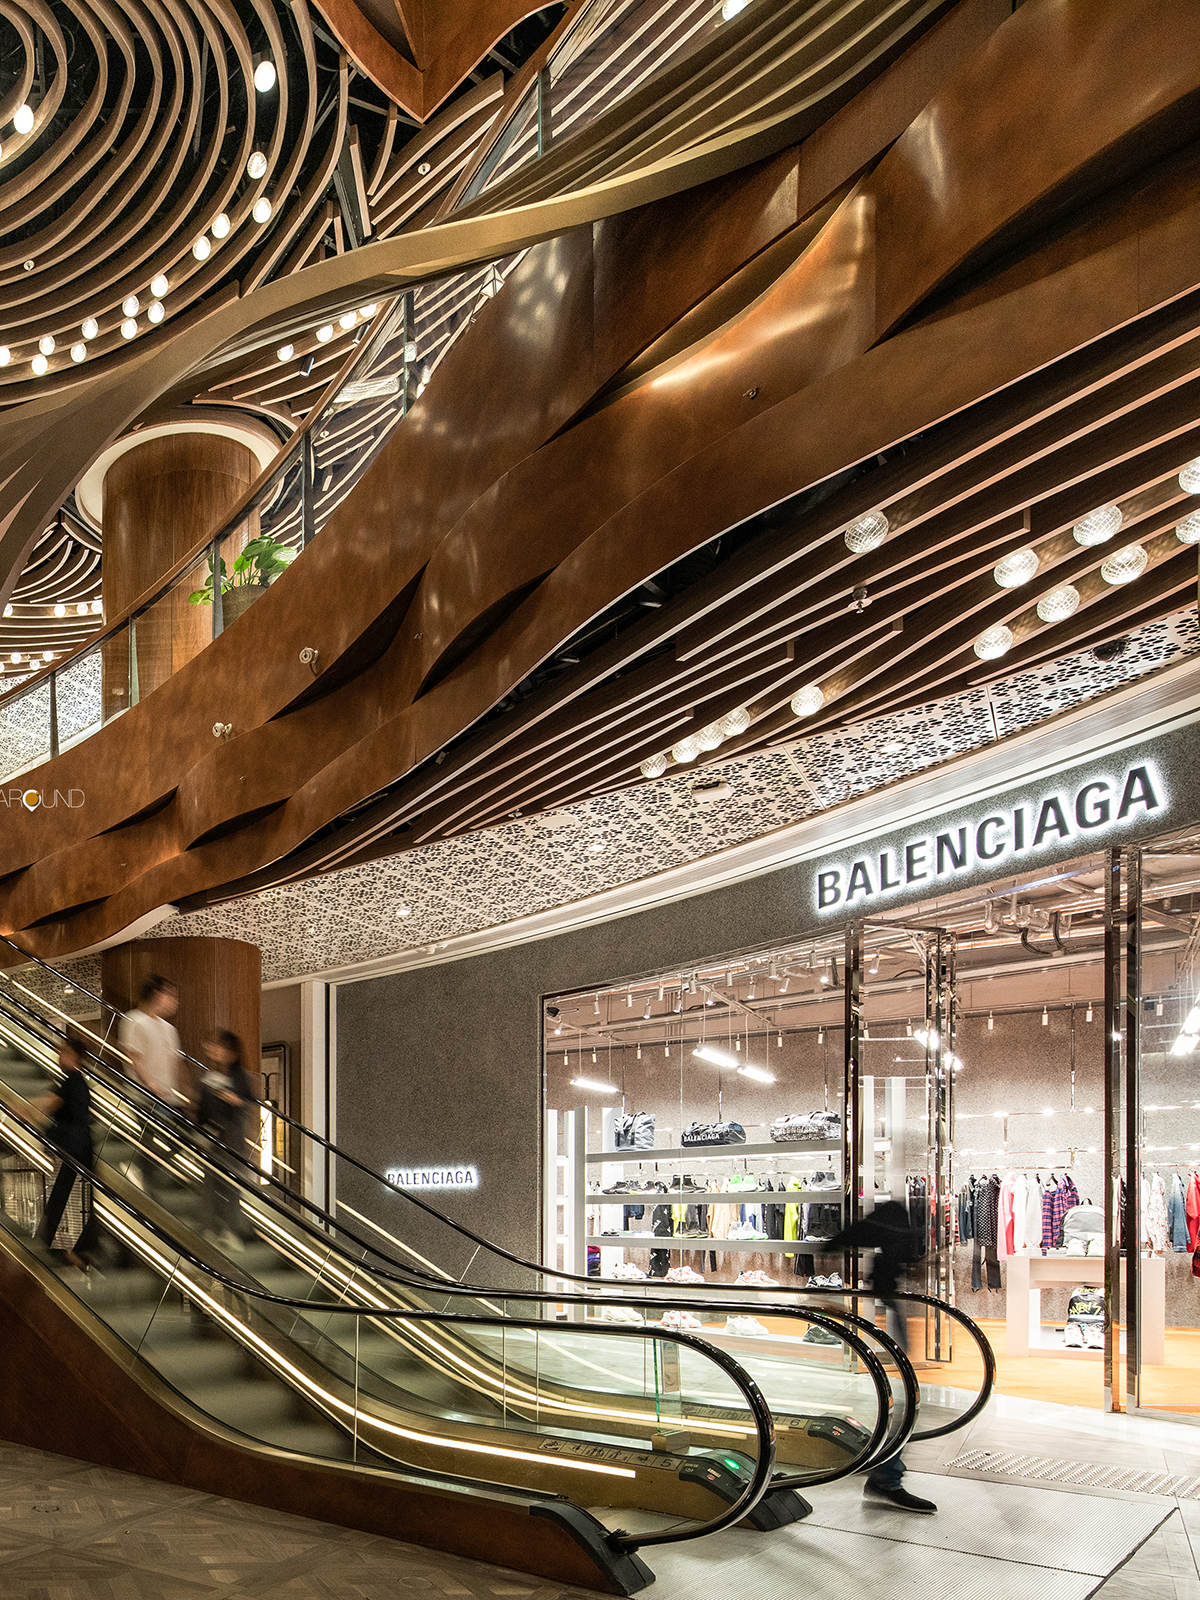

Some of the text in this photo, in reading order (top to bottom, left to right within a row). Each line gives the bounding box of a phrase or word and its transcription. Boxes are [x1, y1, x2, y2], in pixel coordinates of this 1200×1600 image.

[817, 765, 1160, 910] BALENCIAGA
[387, 1170, 474, 1186] BALENCIAGA
[789, 1418, 801, 1427] 6
[660, 1459, 672, 1468] 5
